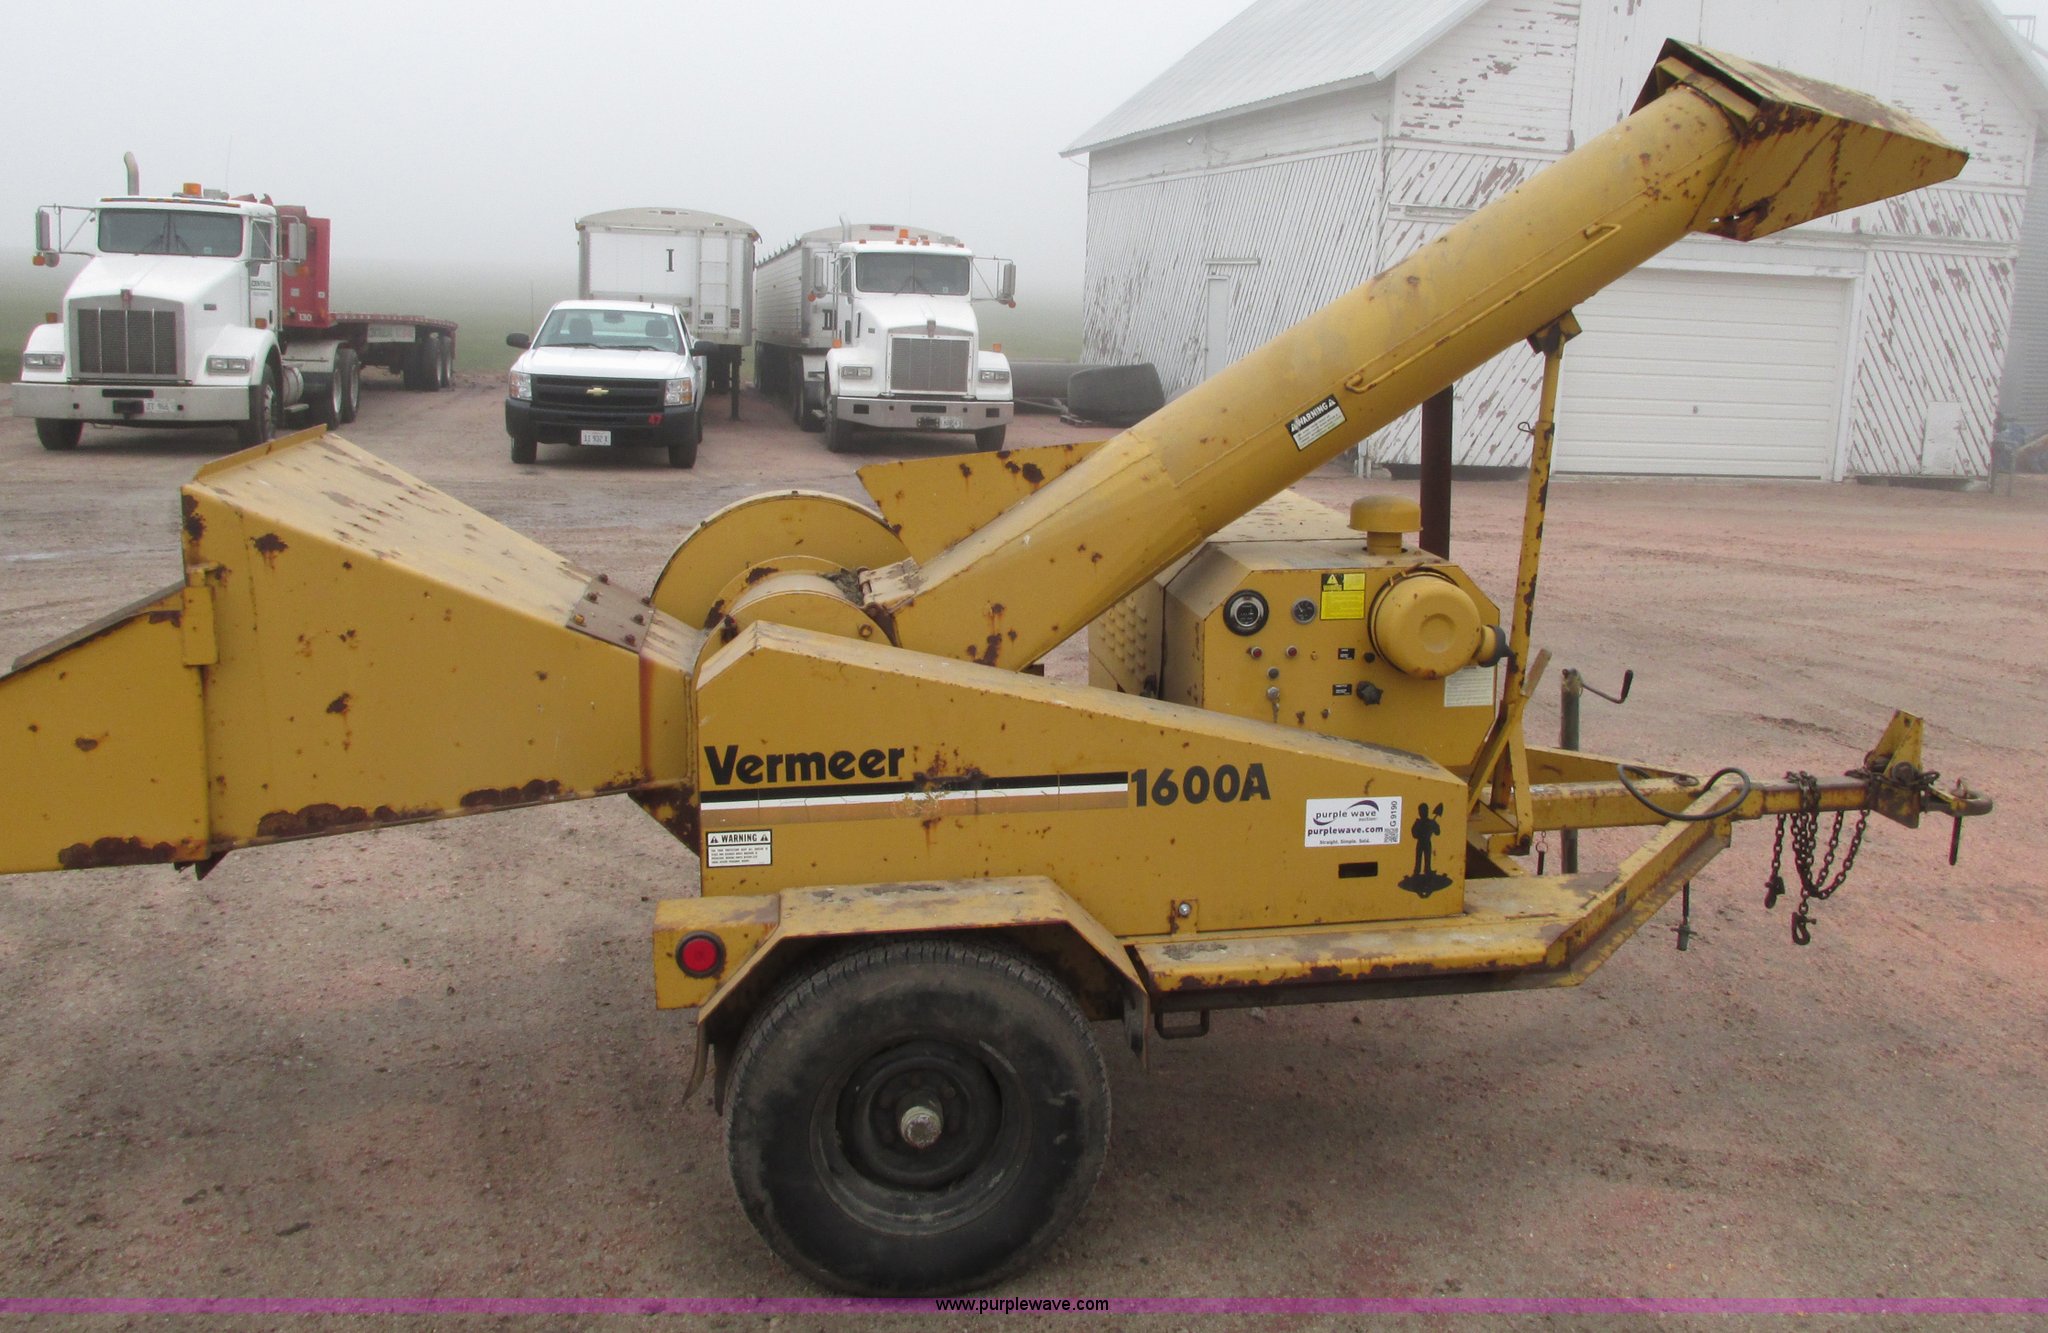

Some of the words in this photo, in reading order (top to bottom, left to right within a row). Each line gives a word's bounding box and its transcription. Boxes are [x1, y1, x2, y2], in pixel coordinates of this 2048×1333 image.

[1294, 401, 1329, 428] WARNING
[704, 744, 905, 785] Vermeer
[1130, 762, 1271, 807] 1600A
[1315, 810, 1348, 819] purple
[721, 833, 758, 843] WARNING
[1307, 826, 1384, 836] purplewave.com
